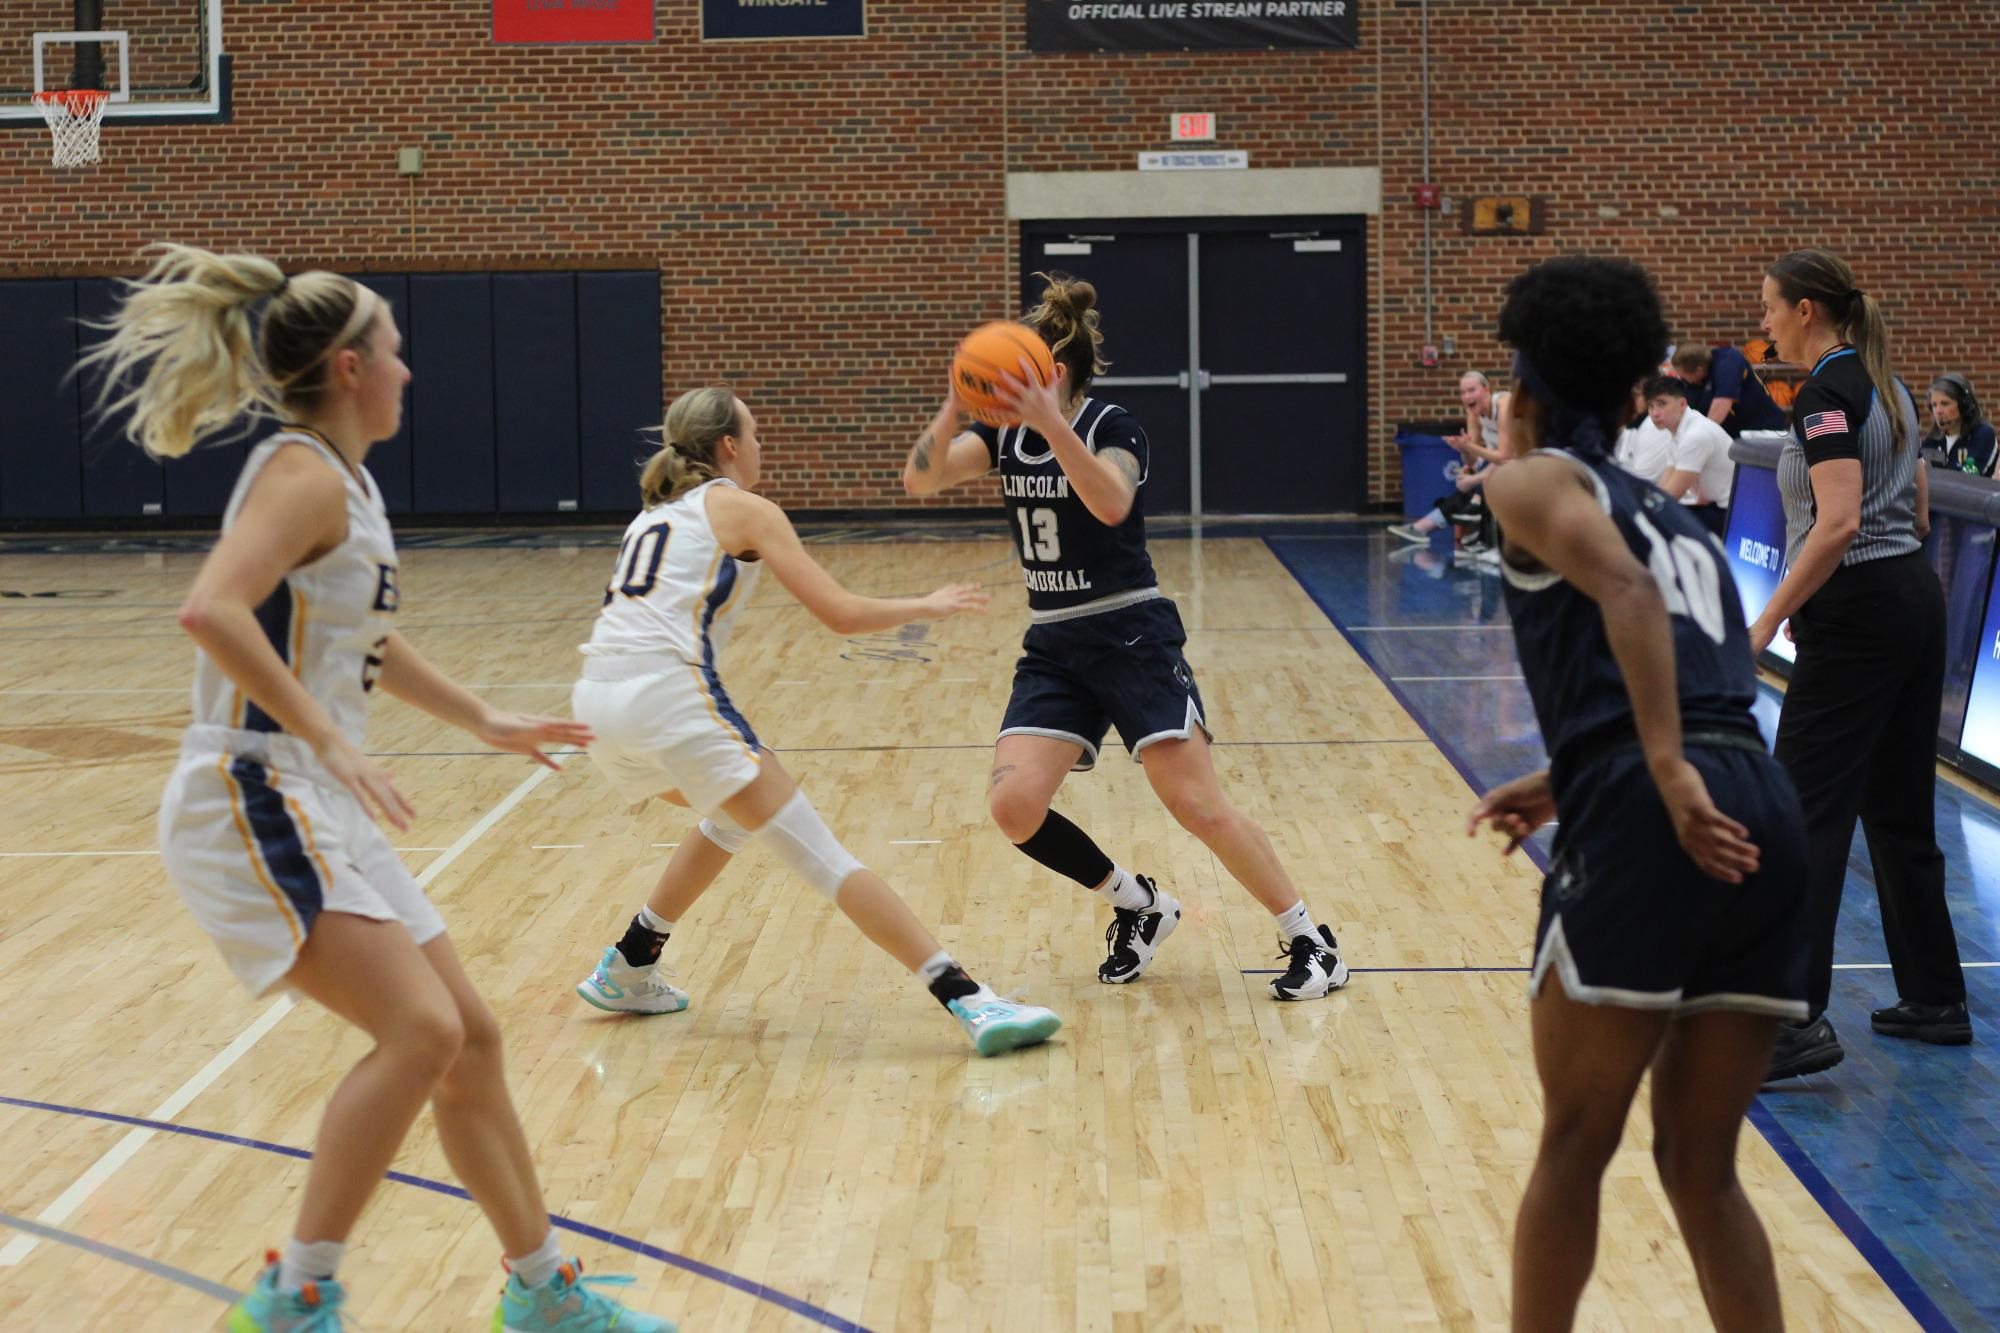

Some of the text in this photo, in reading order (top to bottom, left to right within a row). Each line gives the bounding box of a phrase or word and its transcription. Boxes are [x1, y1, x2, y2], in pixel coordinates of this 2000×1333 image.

[1068, 1, 1346, 19] OFFICIAL LIVE STREAM PARTNER
[1179, 114, 1208, 137] EXIT
[1001, 475, 1069, 498] LINCOLN
[1016, 506, 1061, 562] 13
[1739, 537, 1780, 572] WELCOME TO
